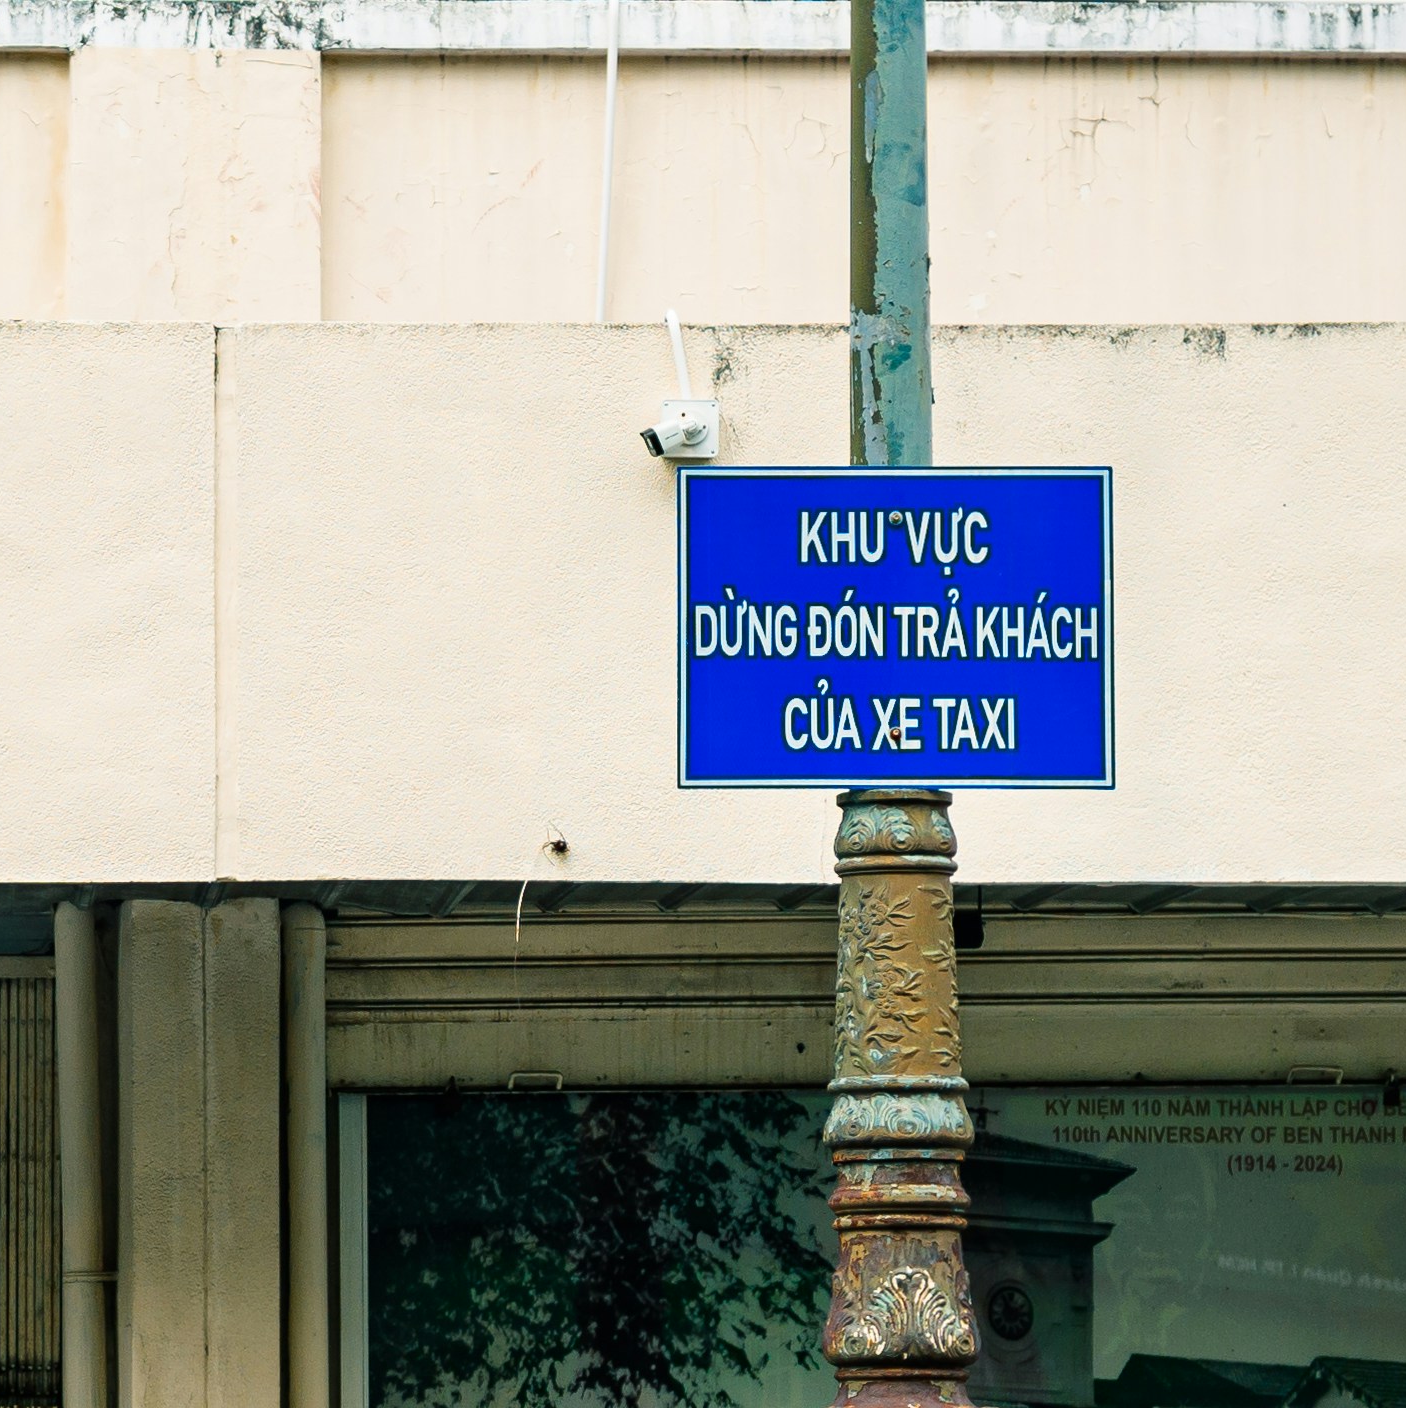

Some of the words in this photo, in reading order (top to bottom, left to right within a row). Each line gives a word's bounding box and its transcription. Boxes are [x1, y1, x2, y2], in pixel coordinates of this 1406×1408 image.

[800, 511, 884, 563] KHU
[905, 507, 989, 576] VỰC
[694, 587, 797, 658] DỪNG
[808, 589, 884, 658] ĐÓN
[894, 588, 967, 659] TRẢ
[976, 592, 1098, 660] KHÁCH
[784, 678, 862, 750] CỦA
[872, 698, 922, 750] XE
[933, 698, 1015, 750] TAXI
[1078, 1096, 1125, 1120] NIỆM
[1131, 1099, 1162, 1117] 110
[1168, 1095, 1211, 1117] NĂM
[1217, 1094, 1283, 1117] THÀNH
[1053, 1126, 1100, 1144] 110th
[1107, 1126, 1246, 1144] ANNIVERSARY
[1250, 1126, 1277, 1144] OF
[1283, 1126, 1323, 1144] BEN
[1329, 1126, 1396, 1144] THANH
[1226, 1154, 1277, 1176] (1914
[1293, 1154, 1343, 1176] 2024)
